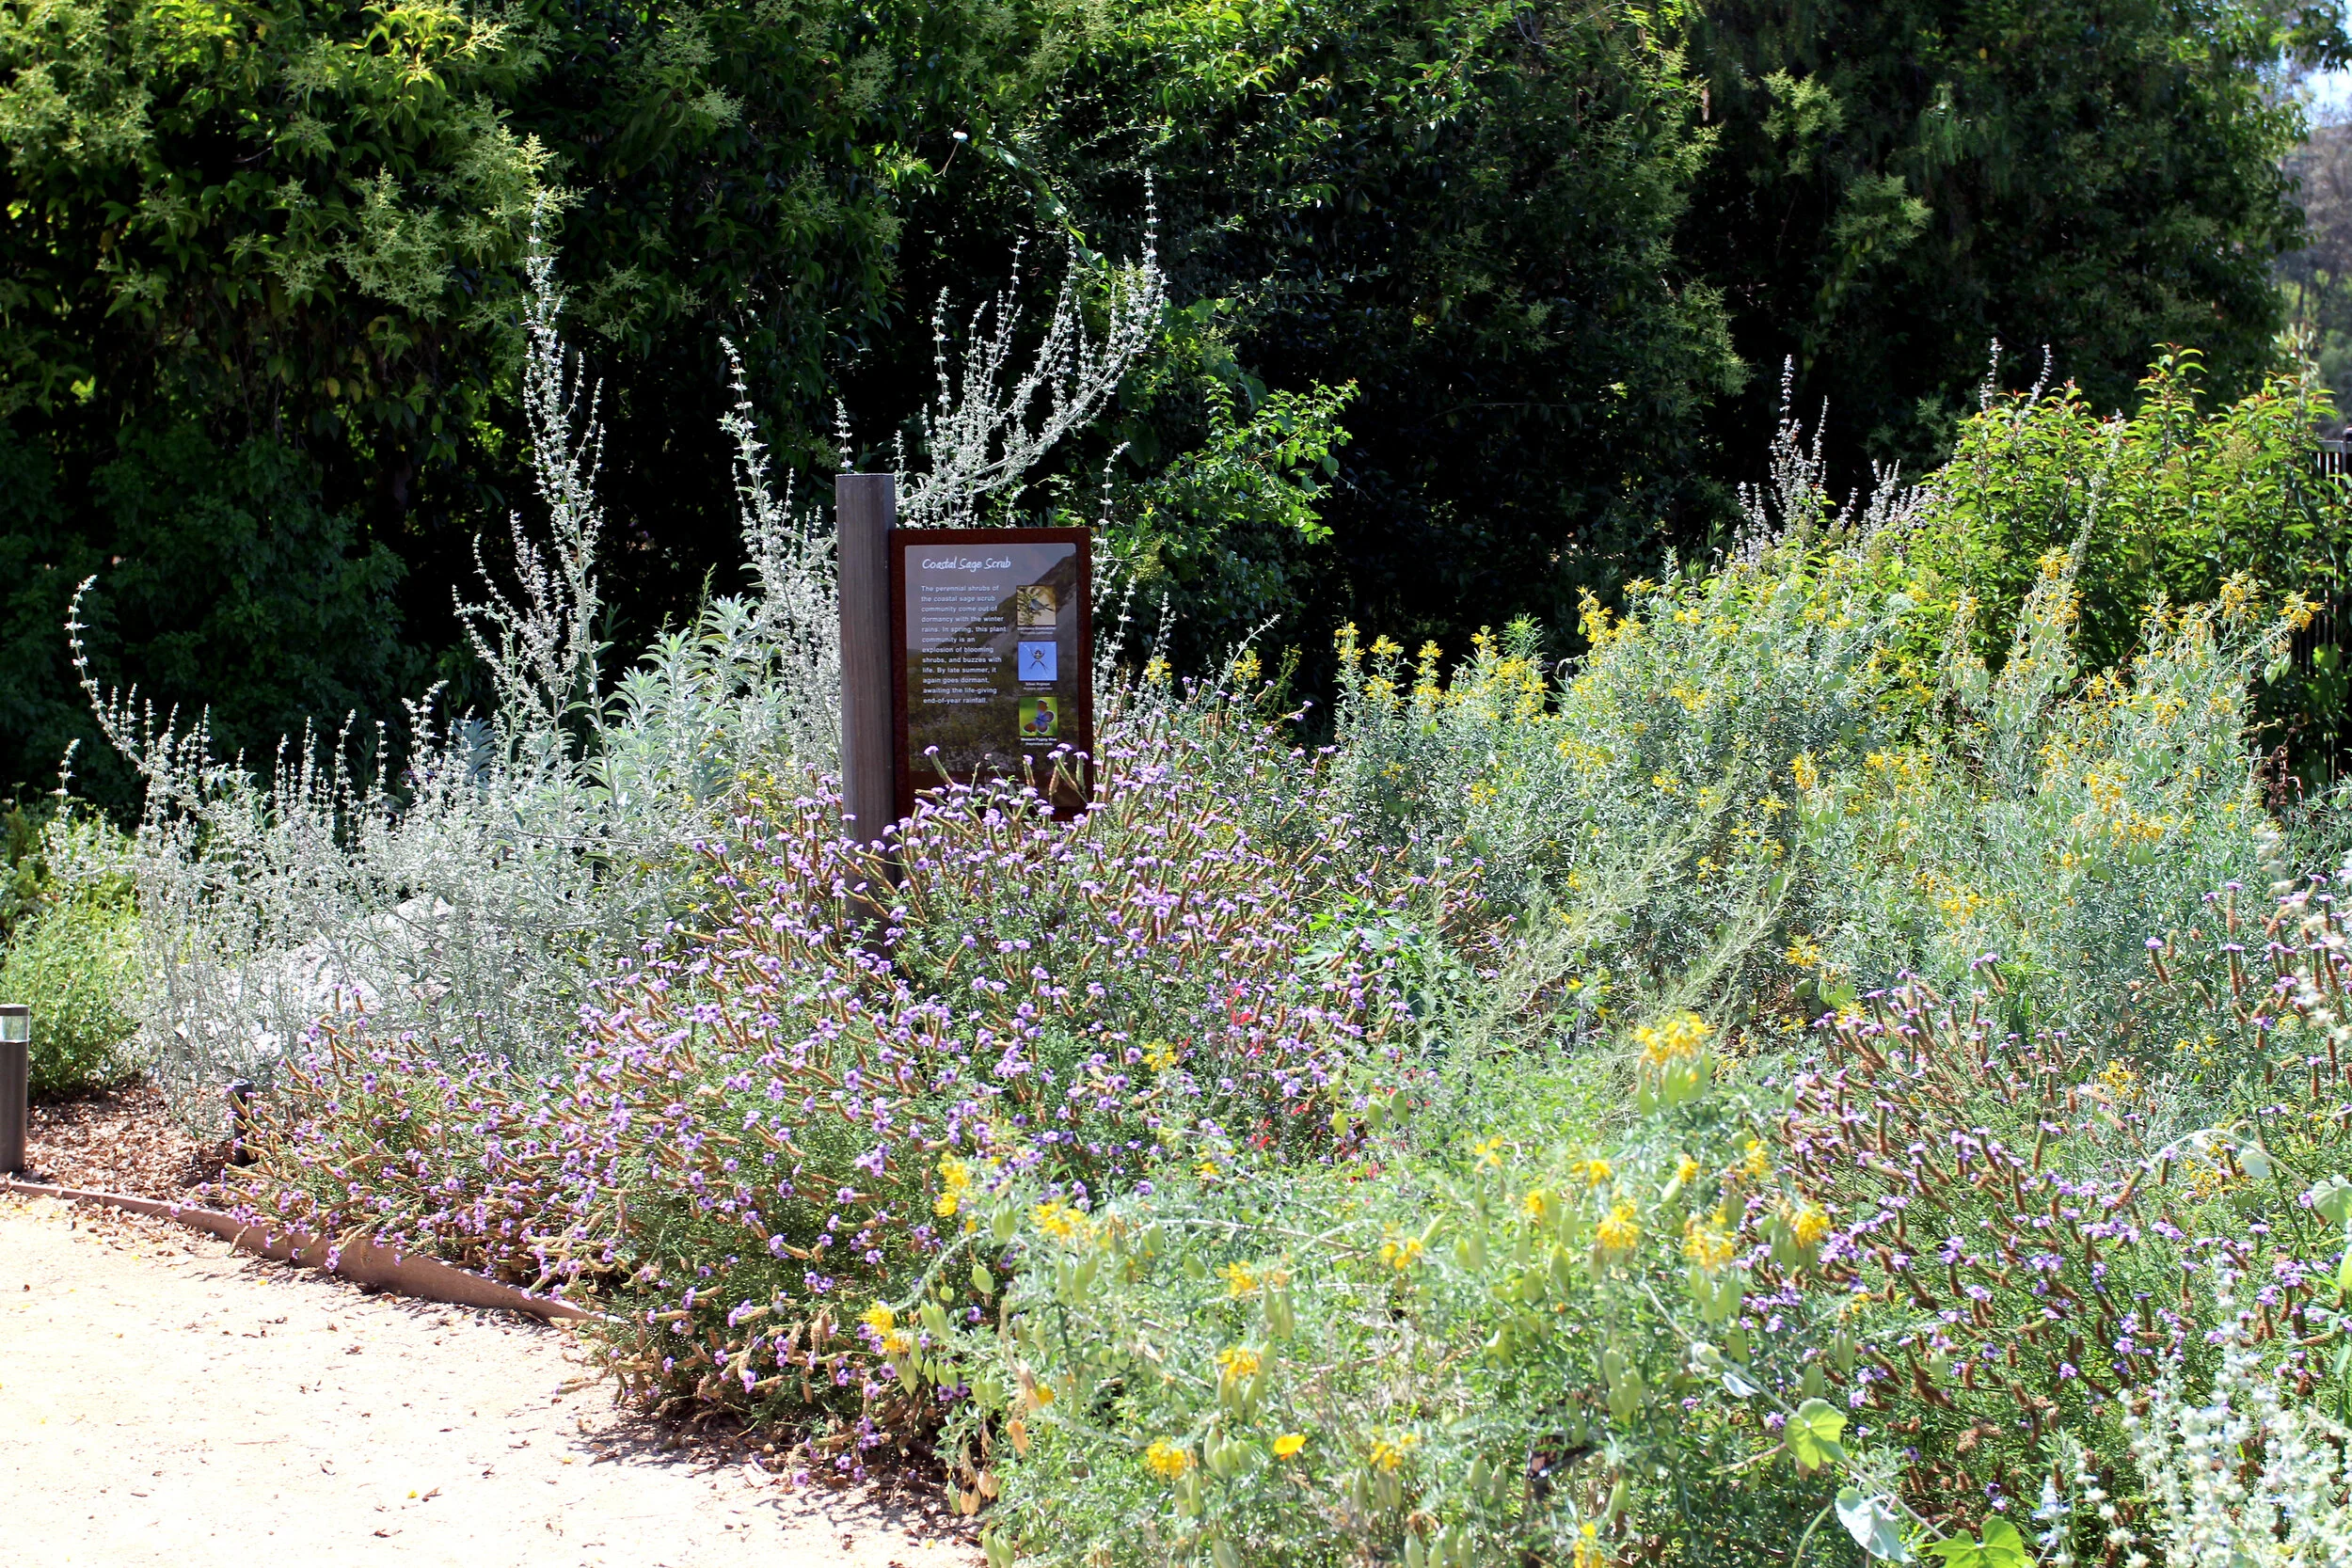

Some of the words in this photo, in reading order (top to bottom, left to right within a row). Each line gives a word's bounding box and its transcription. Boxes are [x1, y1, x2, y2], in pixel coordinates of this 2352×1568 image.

[922, 556, 958, 570] Coastal
[958, 558, 982, 573] Sage
[983, 557, 1011, 570] Scrub
